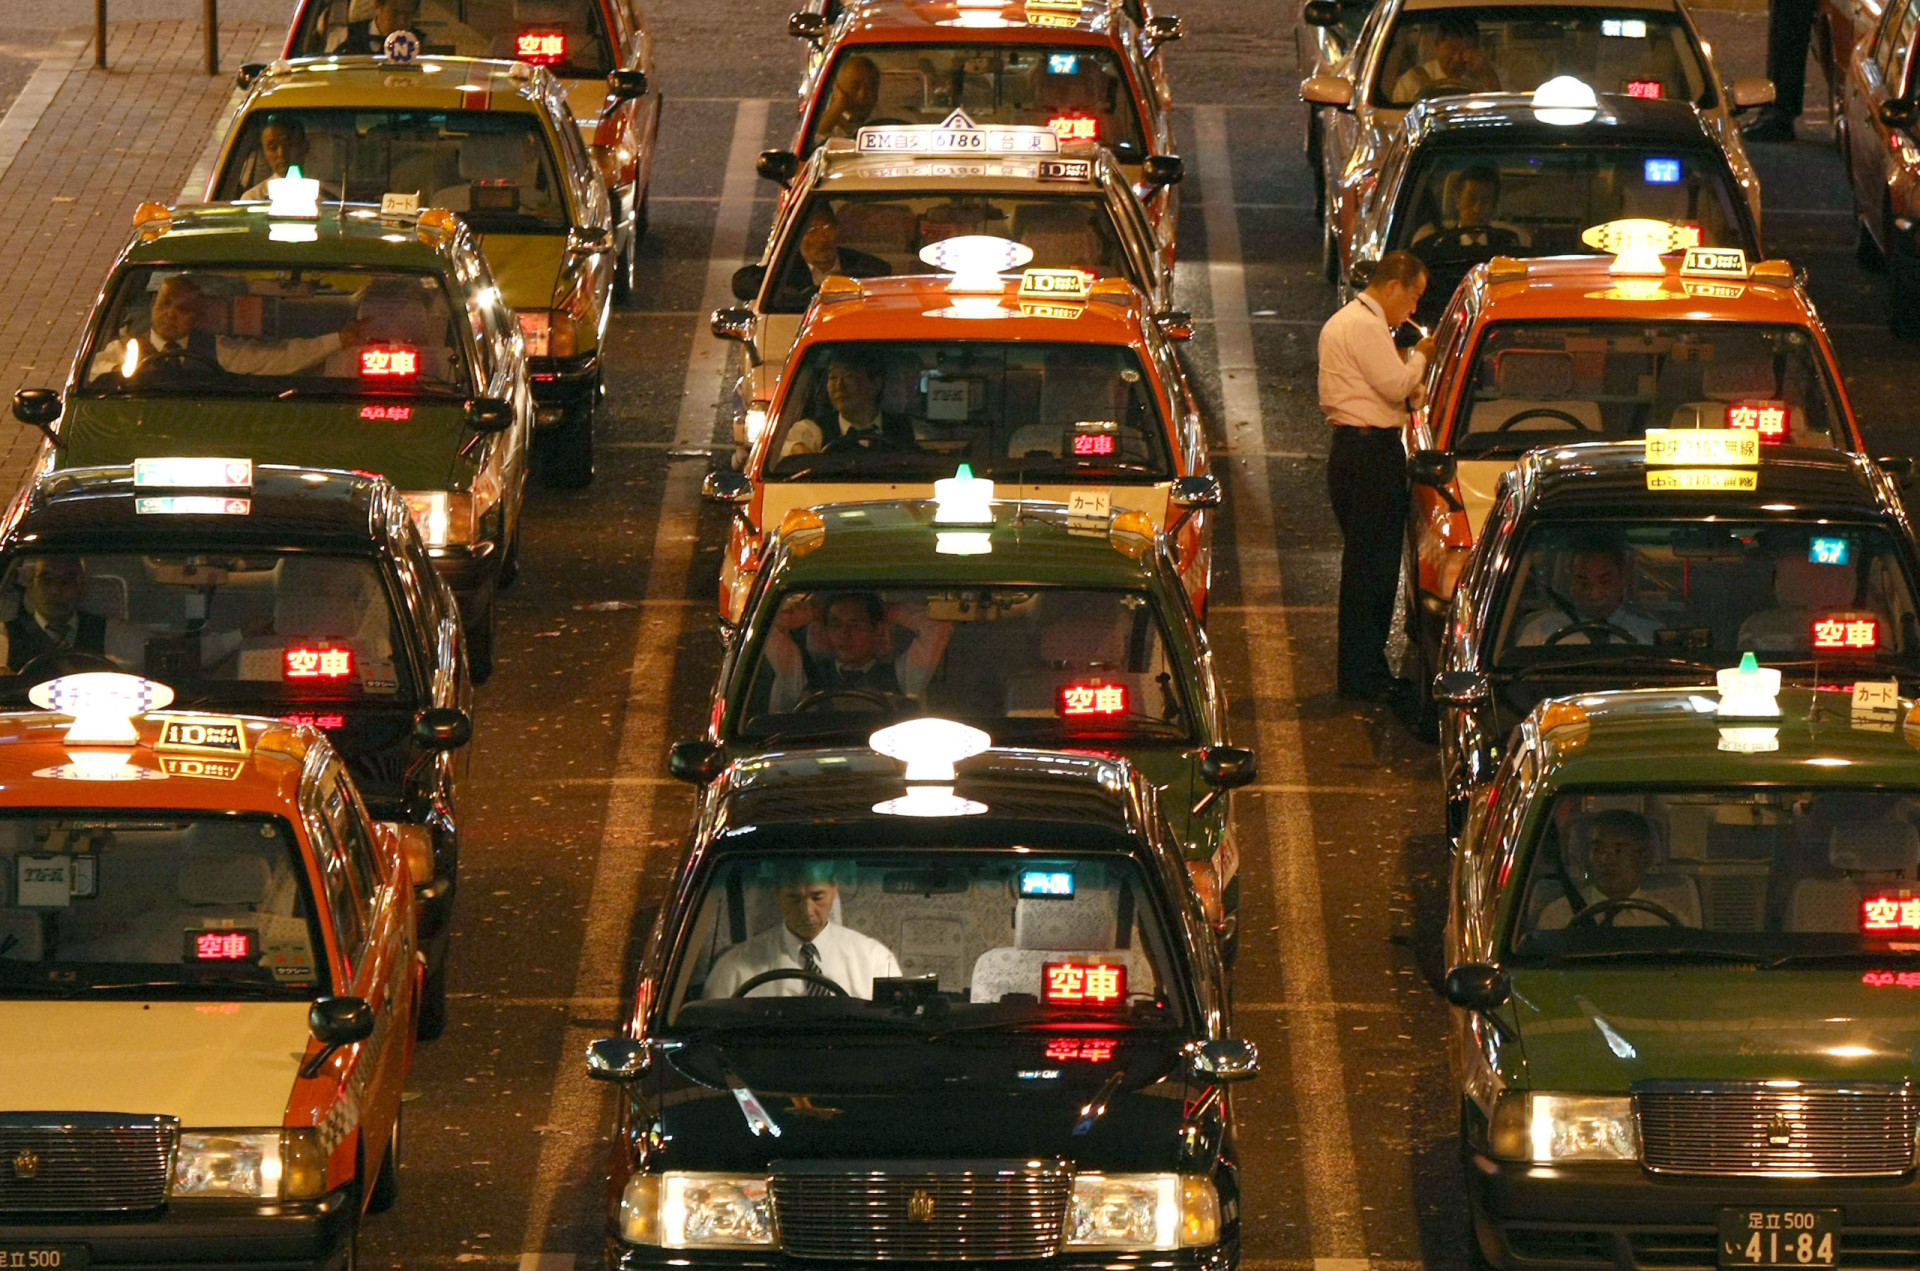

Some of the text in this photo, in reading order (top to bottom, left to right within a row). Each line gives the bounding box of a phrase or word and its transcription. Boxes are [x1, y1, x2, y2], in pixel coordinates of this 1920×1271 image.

[517, 35, 564, 56] 空車
[1627, 81, 1661, 100] 空車
[1050, 117, 1096, 139] 空車
[936, 133, 981, 148] 6186
[387, 197, 414, 211] カード
[362, 350, 416, 375] 空車
[1731, 406, 1784, 435] 空車
[1074, 434, 1114, 455] 空車
[1074, 496, 1105, 511] カード
[1815, 619, 1876, 648] 空車
[288, 649, 350, 677] 空車
[1064, 686, 1124, 714] 空車
[1858, 688, 1892, 703] カード
[168, 725, 206, 745] iD
[197, 933, 248, 959] 空車
[1049, 964, 1120, 1001] 空車
[1745, 1231, 1833, 1263] 41-84
